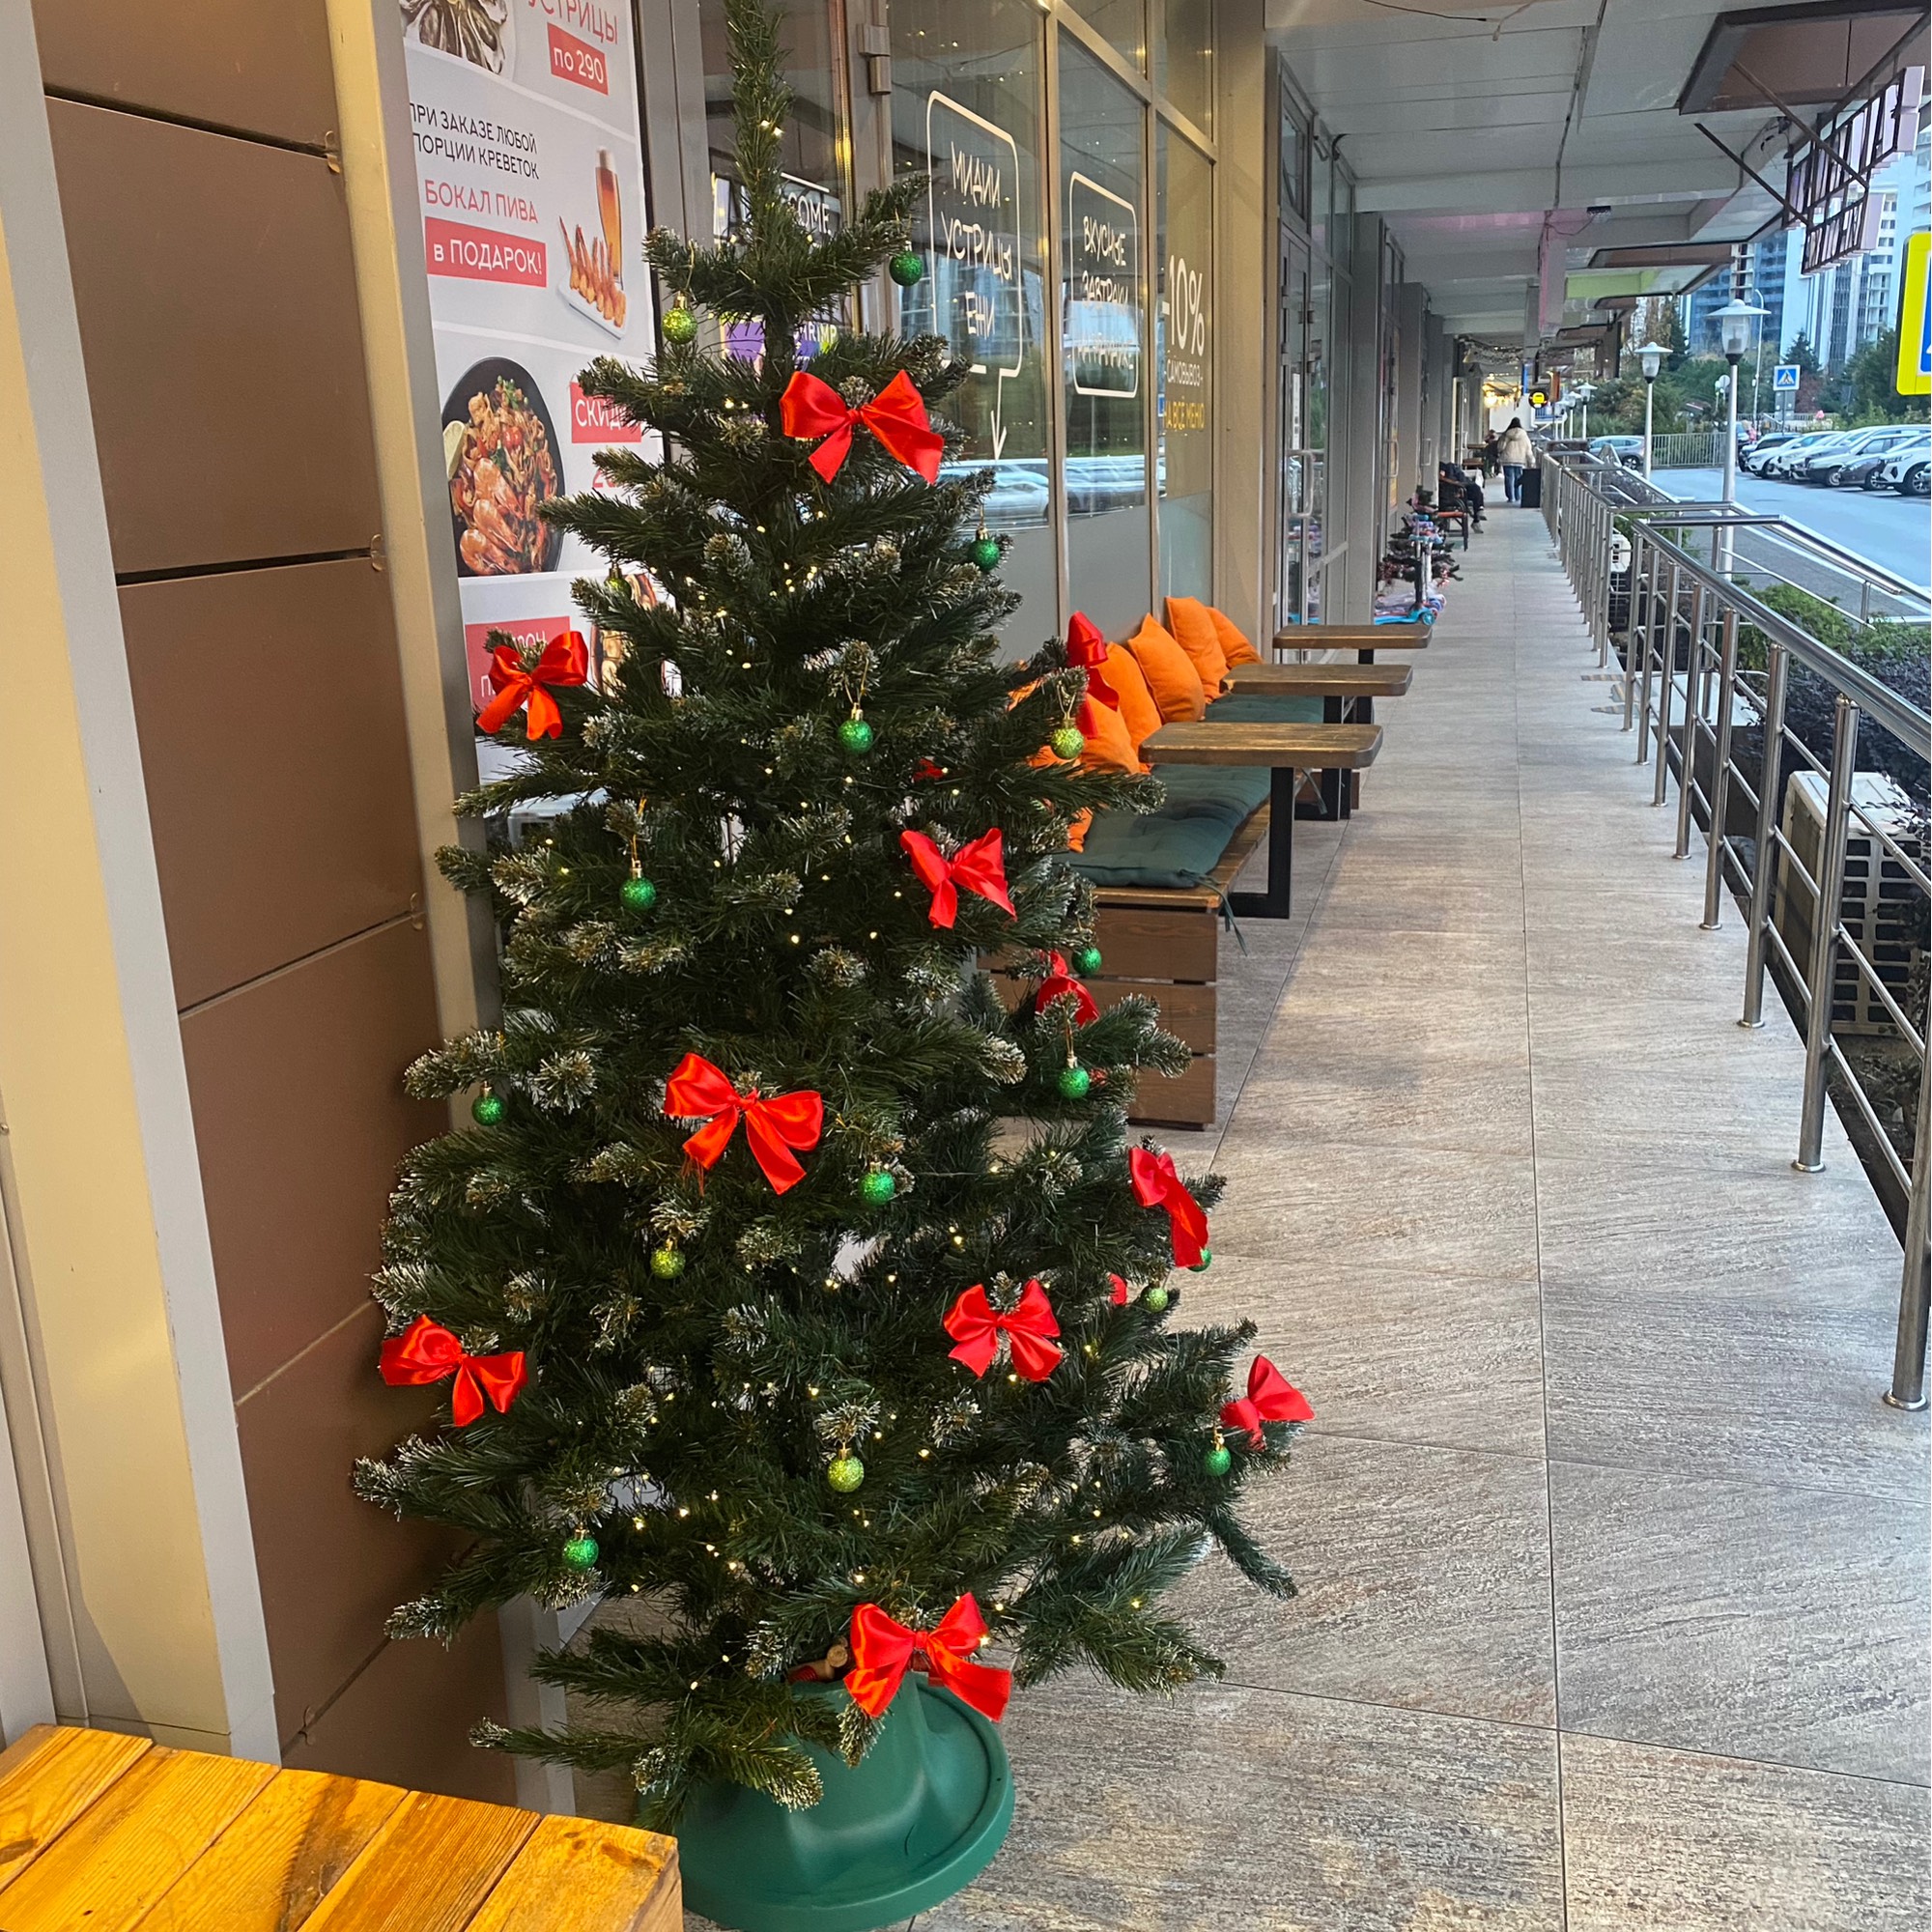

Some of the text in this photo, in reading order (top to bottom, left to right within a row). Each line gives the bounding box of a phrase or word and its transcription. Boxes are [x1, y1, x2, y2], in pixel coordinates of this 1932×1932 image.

[528, 0, 617, 44] ТРИЦЫ
[554, 47, 604, 84] по 290
[440, 111, 495, 141] ЗАКАЗЕ
[497, 126, 537, 155] ЛЮБОЙ
[478, 147, 540, 180] КРЕВЕТОК
[951, 141, 1001, 209] МИДИИ
[425, 180, 539, 224] БОКАЛ ПИВА
[450, 239, 543, 274] ПОДАРОК!
[941, 211, 1012, 284] УСТРИЦЫ
[1162, 255, 1205, 357] -10%
[575, 398, 639, 432] СКИД
